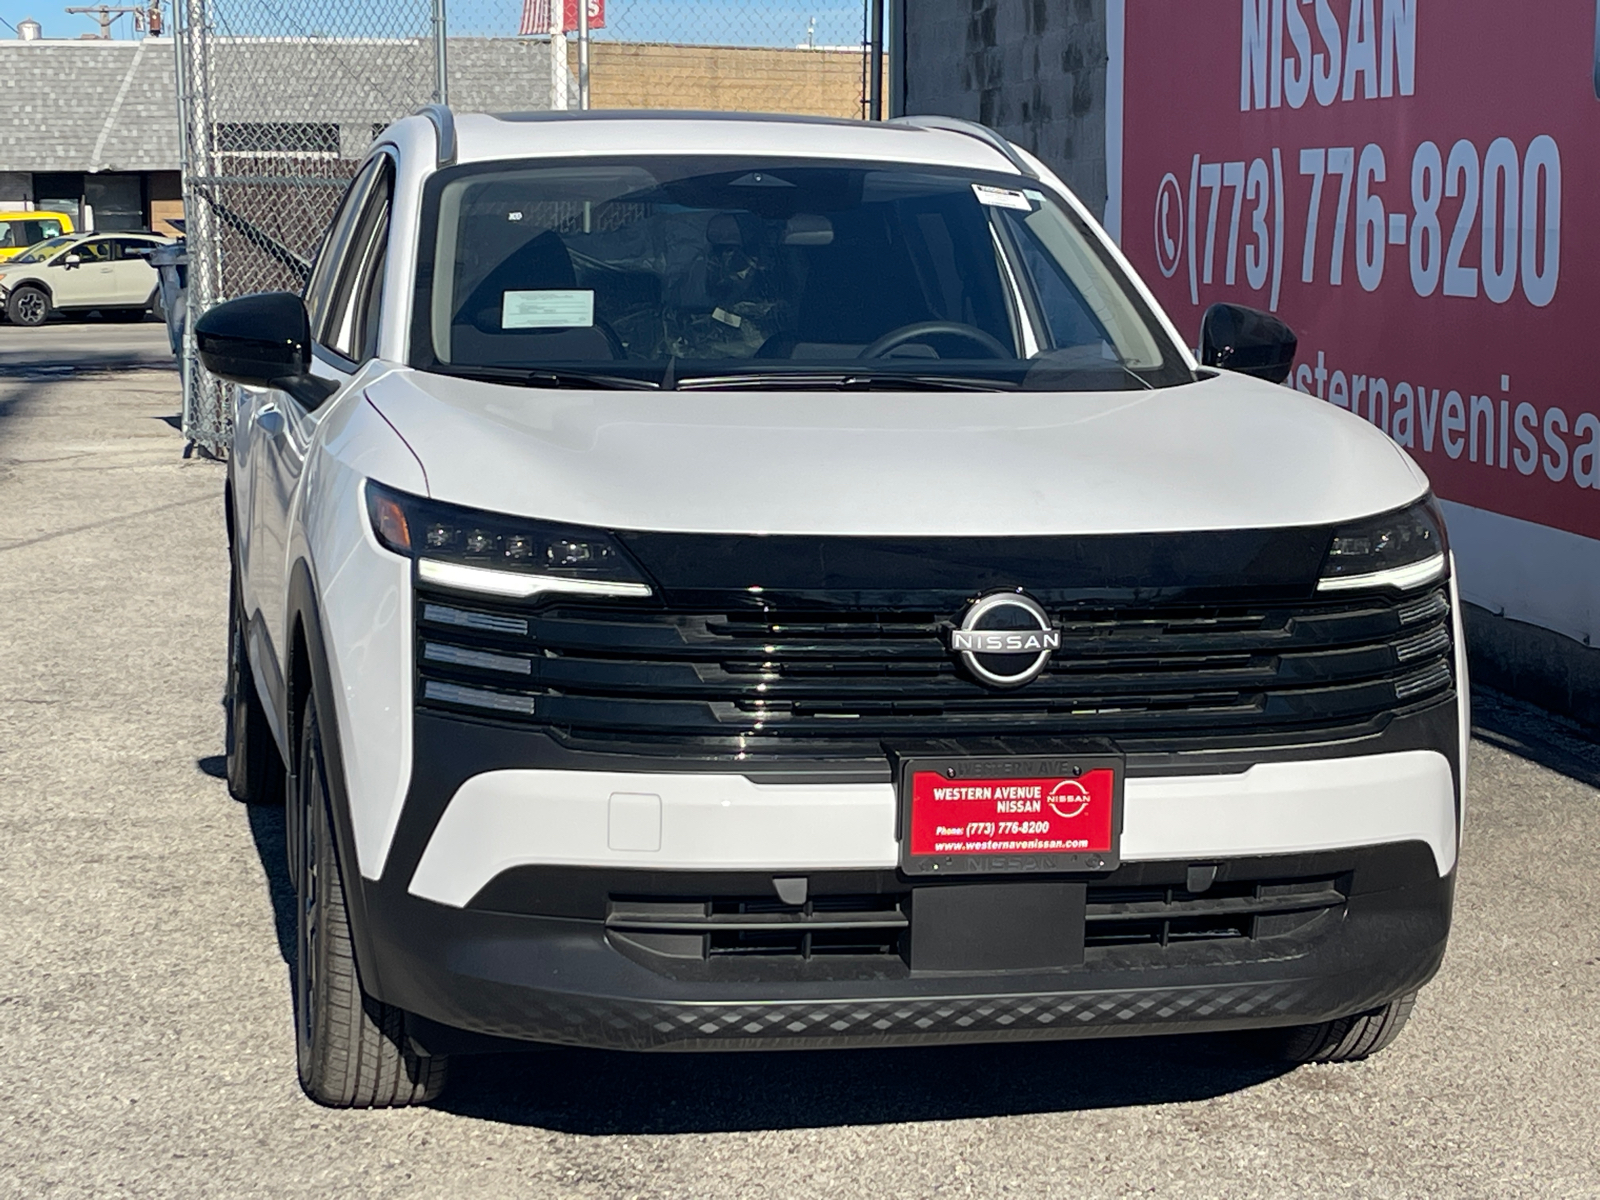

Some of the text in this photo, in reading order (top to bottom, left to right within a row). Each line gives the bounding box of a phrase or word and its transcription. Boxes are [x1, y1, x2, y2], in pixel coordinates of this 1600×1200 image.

[1240, 0, 1417, 111] NISSAN
[1188, 135, 1562, 312] (773) 776-8200
[955, 633, 1059, 650] NISSAN
[958, 762, 1033, 778] WESTERN
[933, 786, 1042, 801] WESTERN AVENUE
[1046, 795, 1091, 803] NISSAN
[997, 800, 1041, 813] NISSAN
[936, 821, 1050, 838] Phone: (773) 776-8200
[935, 838, 1089, 851] www.westernavenissan.com
[966, 855, 1057, 871] NISSAN
